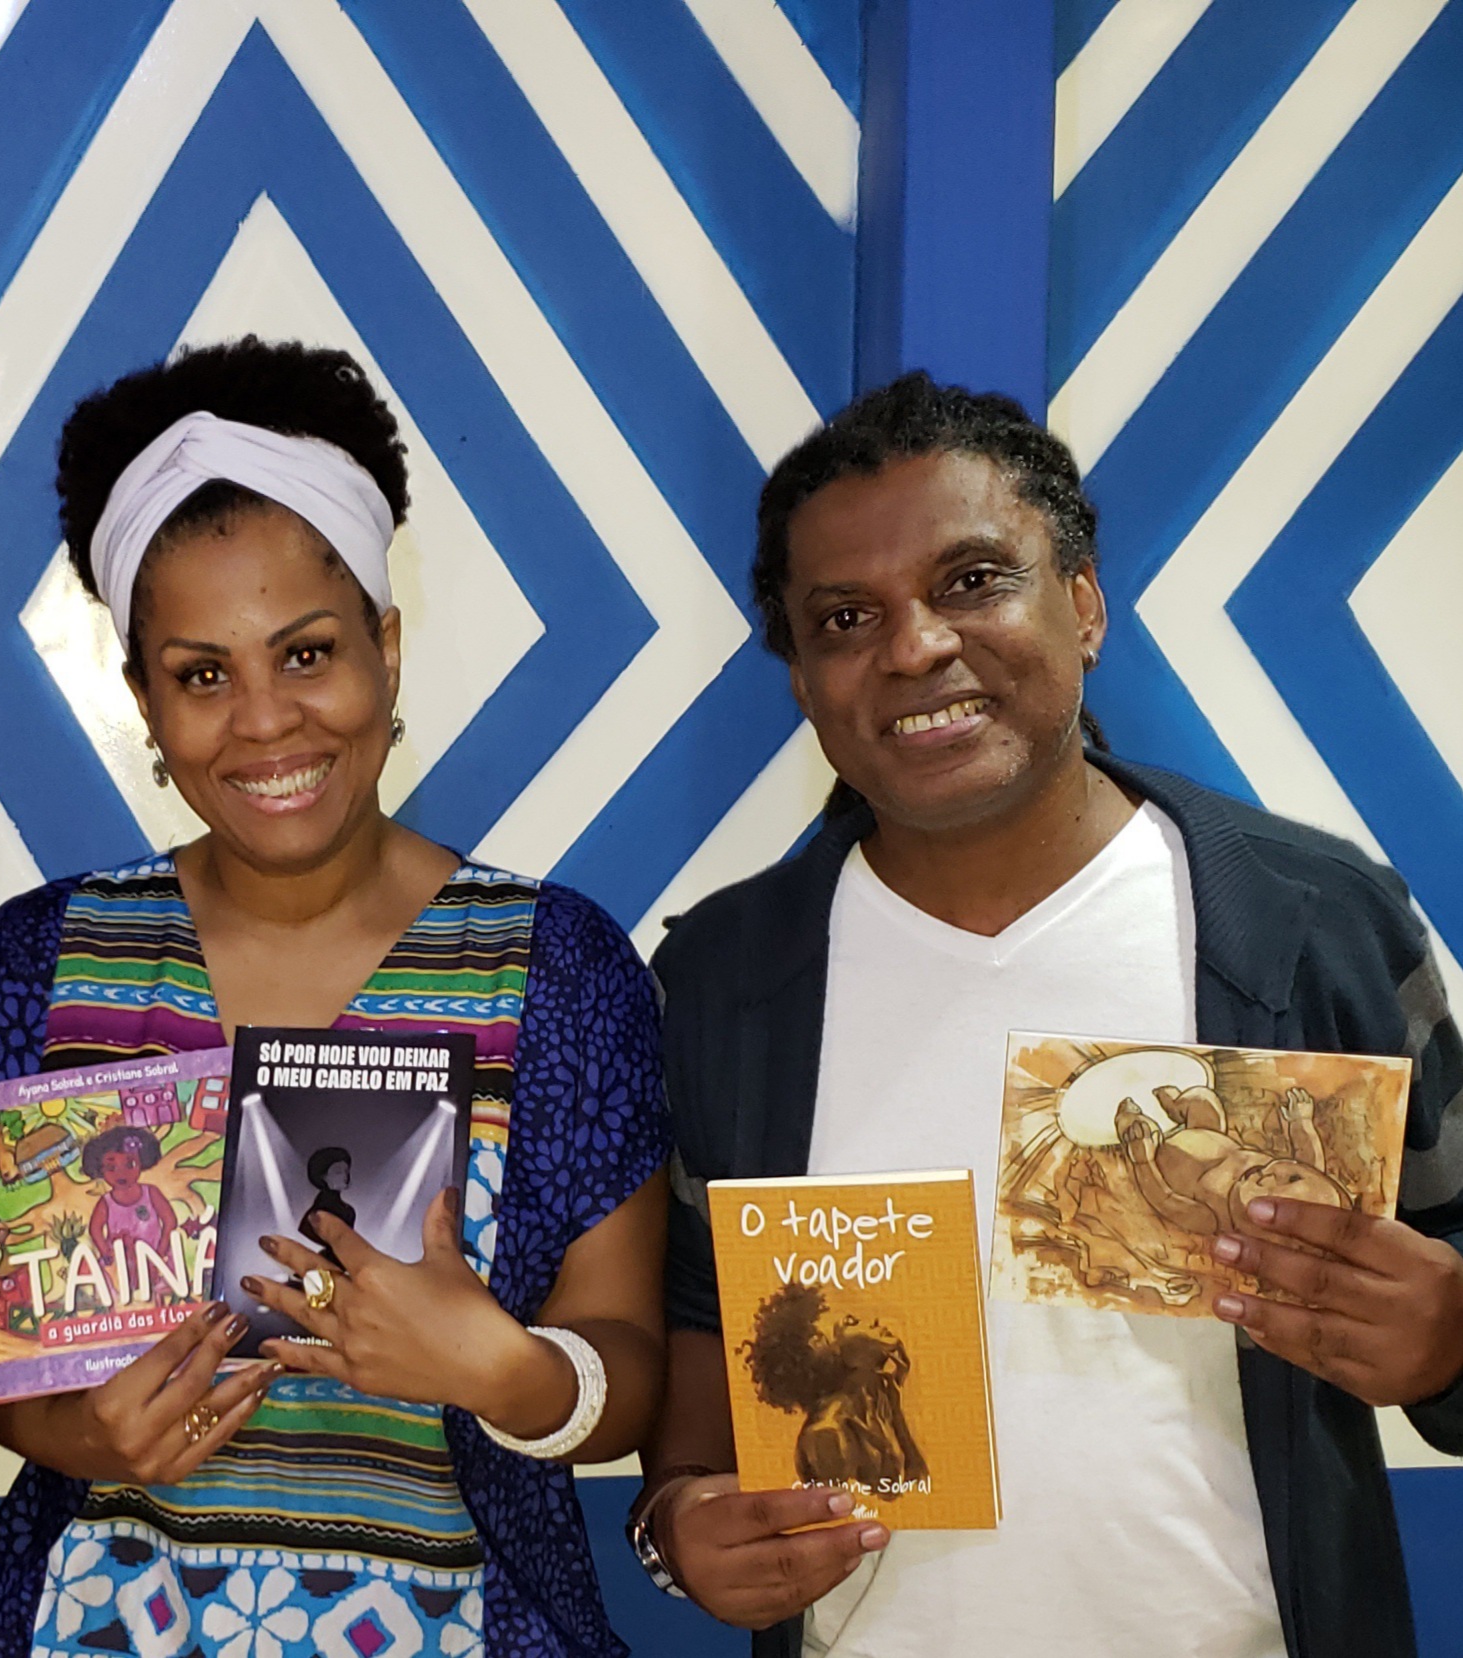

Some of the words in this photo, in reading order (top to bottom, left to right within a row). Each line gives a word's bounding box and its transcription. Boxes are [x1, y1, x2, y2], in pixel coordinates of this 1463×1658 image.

[259, 1039, 282, 1063] SÓ
[283, 1043, 316, 1065] POR
[318, 1045, 356, 1066] HOJE
[358, 1046, 391, 1067] VOU
[393, 1047, 450, 1069] DEIXAR
[18, 1083, 49, 1100] Ayana
[50, 1076, 85, 1092] Sobral
[85, 1077, 93, 1086] e
[95, 1068, 143, 1084] Cristiane
[144, 1061, 179, 1078] Sobral
[256, 1066, 270, 1087] O
[273, 1067, 313, 1088] MEU
[315, 1068, 383, 1090] CABELO
[385, 1070, 413, 1091] EM
[415, 1071, 450, 1092] PAZ
[740, 1203, 766, 1237] O
[781, 1197, 934, 1251] tapete
[8, 1205, 217, 1318] TAINÁ
[47, 1327, 58, 1340] a
[128, 1312, 154, 1329] das
[877, 1474, 932, 1495] Sobral
